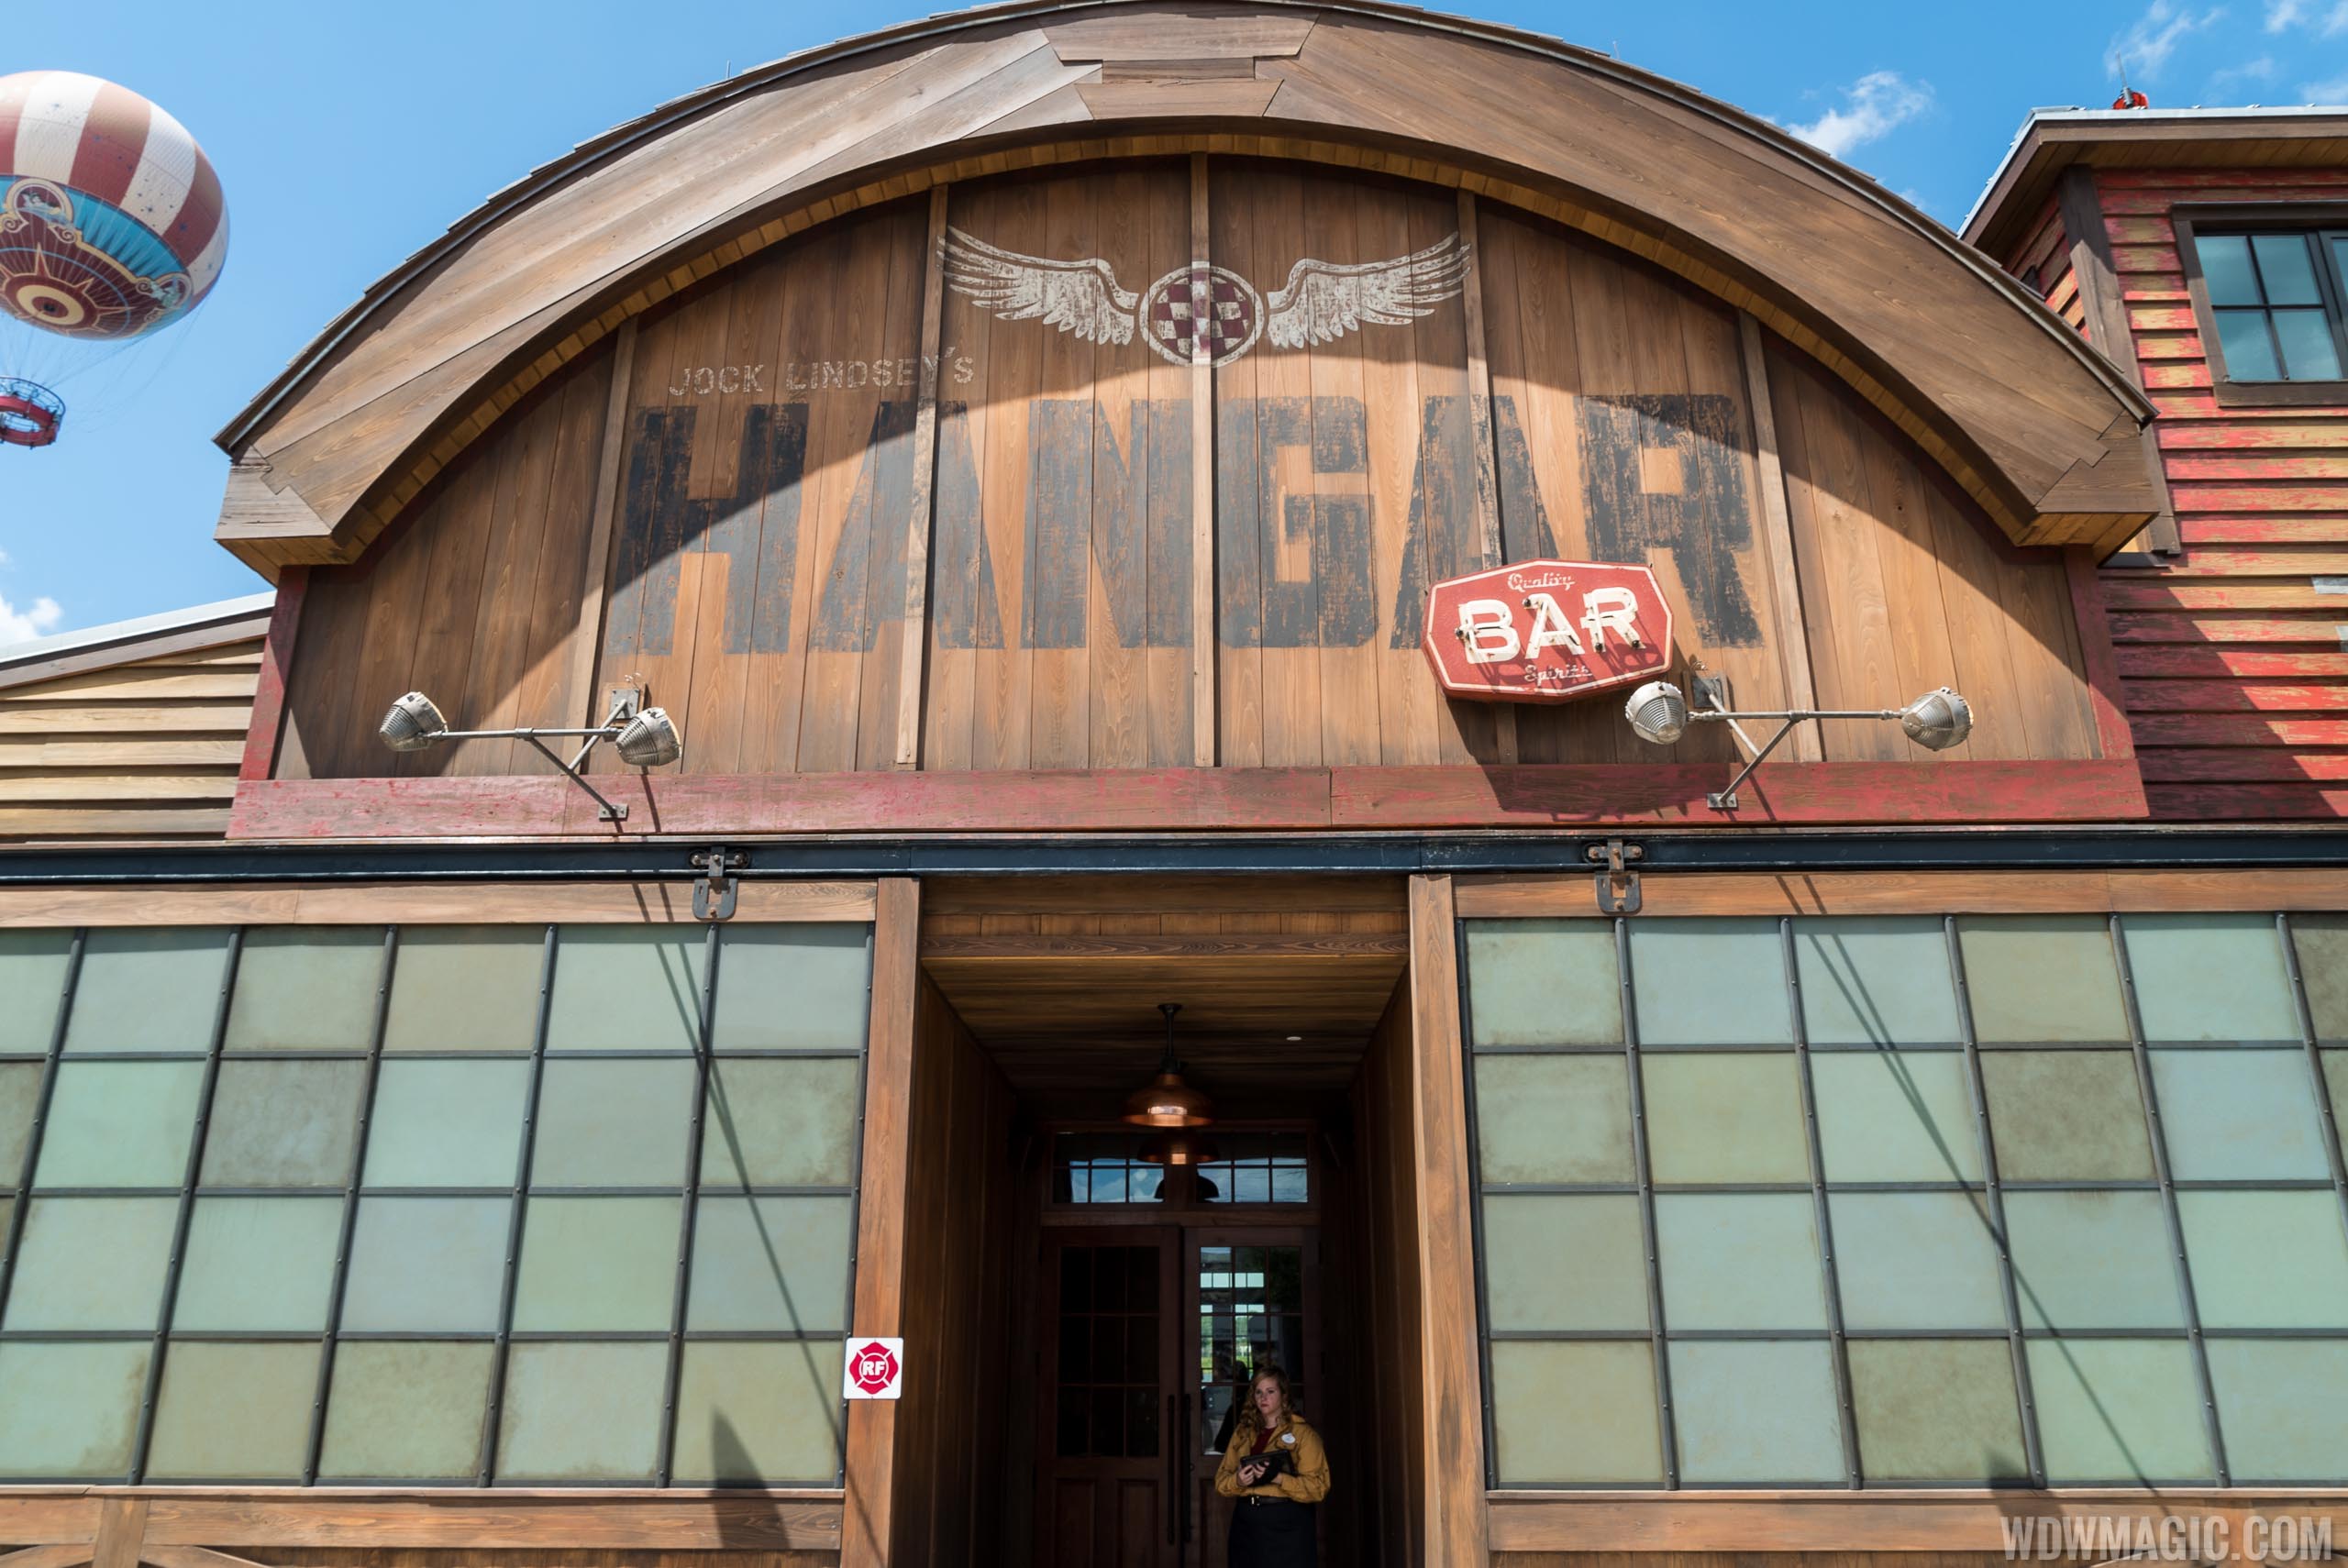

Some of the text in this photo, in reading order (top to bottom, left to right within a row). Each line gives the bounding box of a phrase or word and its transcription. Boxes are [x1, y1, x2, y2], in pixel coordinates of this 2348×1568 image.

[669, 347, 974, 395] JOCK LINDSEY'S
[607, 394, 1765, 654] HANGAR
[1507, 572, 1576, 592] Quality
[1456, 587, 1646, 664] BAR
[1524, 664, 1593, 687] Spirits
[862, 1361, 885, 1376] RF
